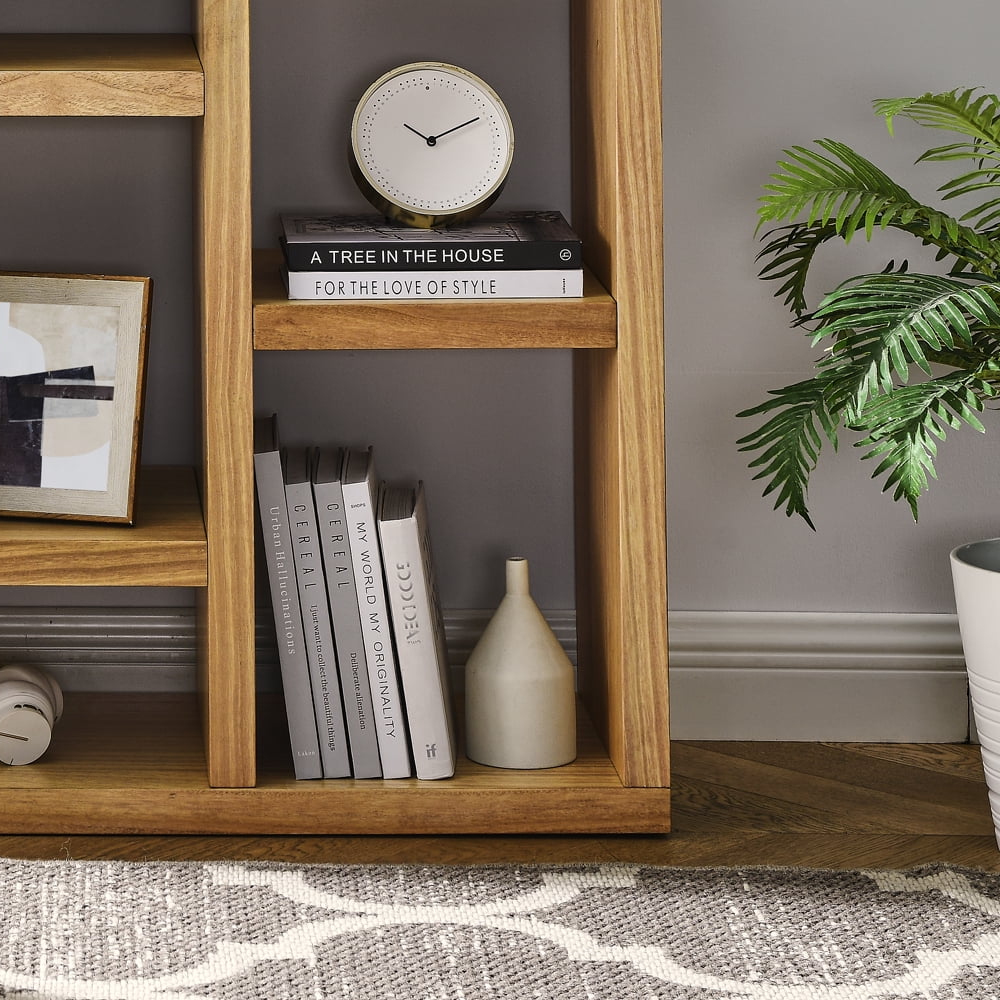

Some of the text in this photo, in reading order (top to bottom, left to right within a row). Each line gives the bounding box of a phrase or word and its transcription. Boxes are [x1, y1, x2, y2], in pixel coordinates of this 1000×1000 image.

[310, 248, 504, 264] A TREE IN THE HOUSE
[315, 279, 497, 296] FOR THE LOVE OF STYLE
[294, 503, 316, 590] CEREAL
[326, 503, 350, 589] CEREAL
[269, 506, 296, 655] Urban Hallucinations
[309, 608, 319, 624] just
[313, 624, 322, 644] want
[356, 521, 396, 739] MY WORLD MY ORIGINALITY
[316, 644, 323, 653] to
[317, 653, 327, 678] collect
[320, 678, 328, 692] the
[350, 652, 366, 730] Deliberate alienation
[322, 692, 334, 726] beautiful
[326, 726, 336, 752] things
